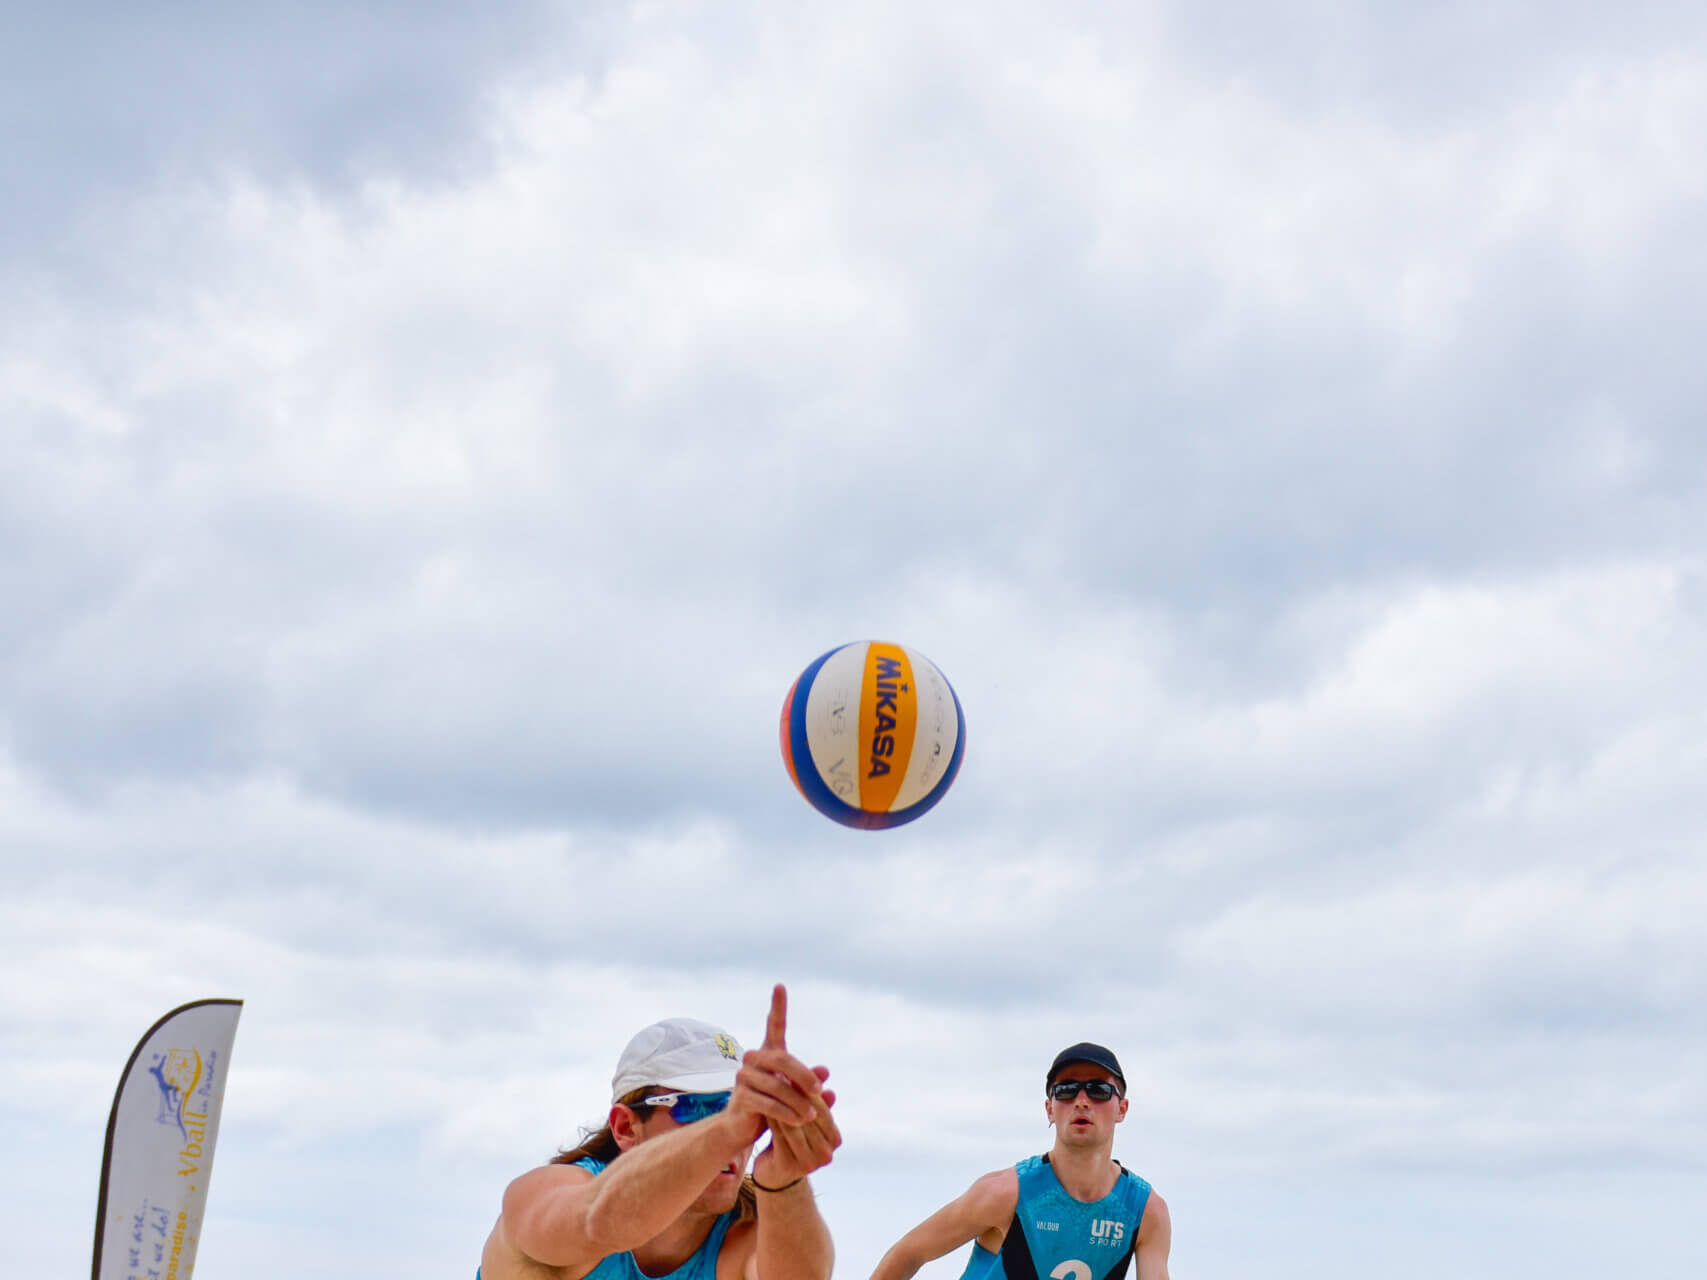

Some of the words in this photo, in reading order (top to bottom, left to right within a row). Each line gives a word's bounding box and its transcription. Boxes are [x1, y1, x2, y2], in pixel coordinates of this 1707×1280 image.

[177, 1111, 208, 1176] Vball
[152, 1206, 171, 1238] do!
[1036, 1220, 1060, 1232] VALOUR
[1091, 1218, 1125, 1240] UTS
[154, 1242, 165, 1263] we
[1089, 1236, 1123, 1248] SPORT
[129, 1248, 141, 1268] we
